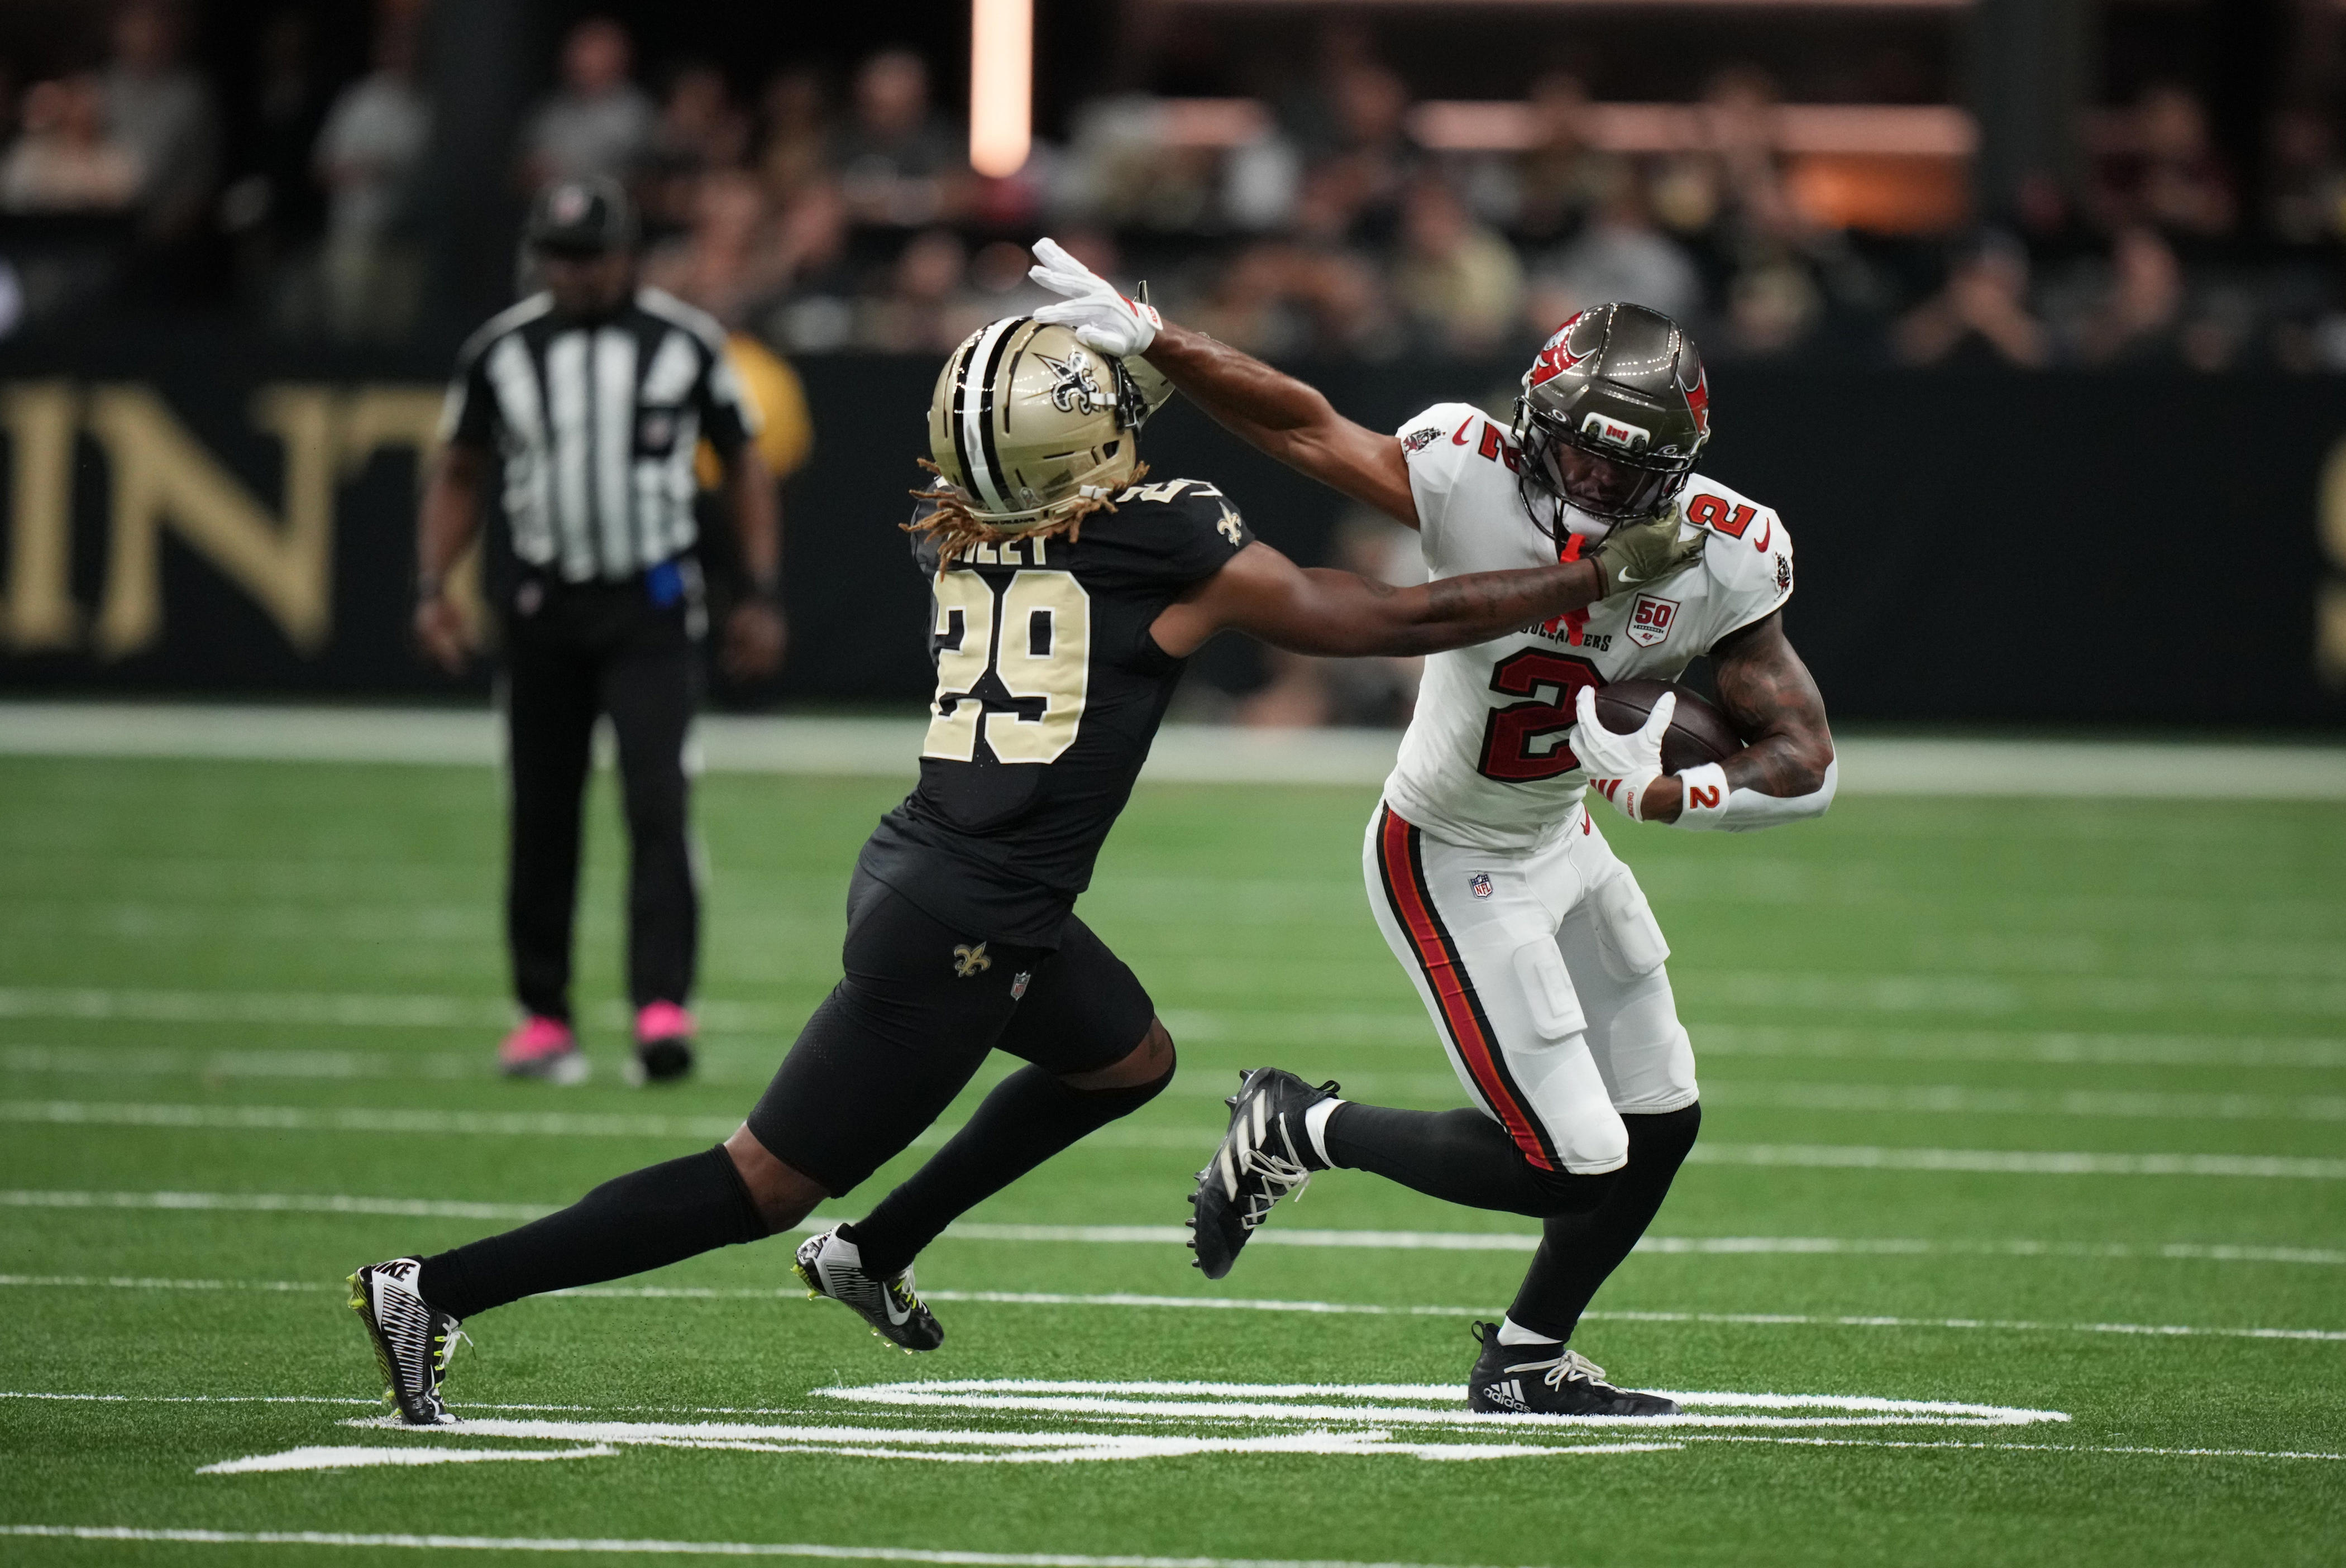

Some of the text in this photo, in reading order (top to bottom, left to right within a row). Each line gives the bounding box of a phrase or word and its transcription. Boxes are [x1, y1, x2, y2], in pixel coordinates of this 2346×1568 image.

[1686, 493, 1757, 540] 2
[1635, 600, 1672, 628] 50
[1520, 623, 1612, 652] UCAERS
[923, 569, 1090, 764] 29
[1477, 646, 1609, 783] 2
[1690, 785, 1721, 809] 2
[1475, 883, 1491, 895] NFL
[1483, 1387, 1532, 1413] adidas
